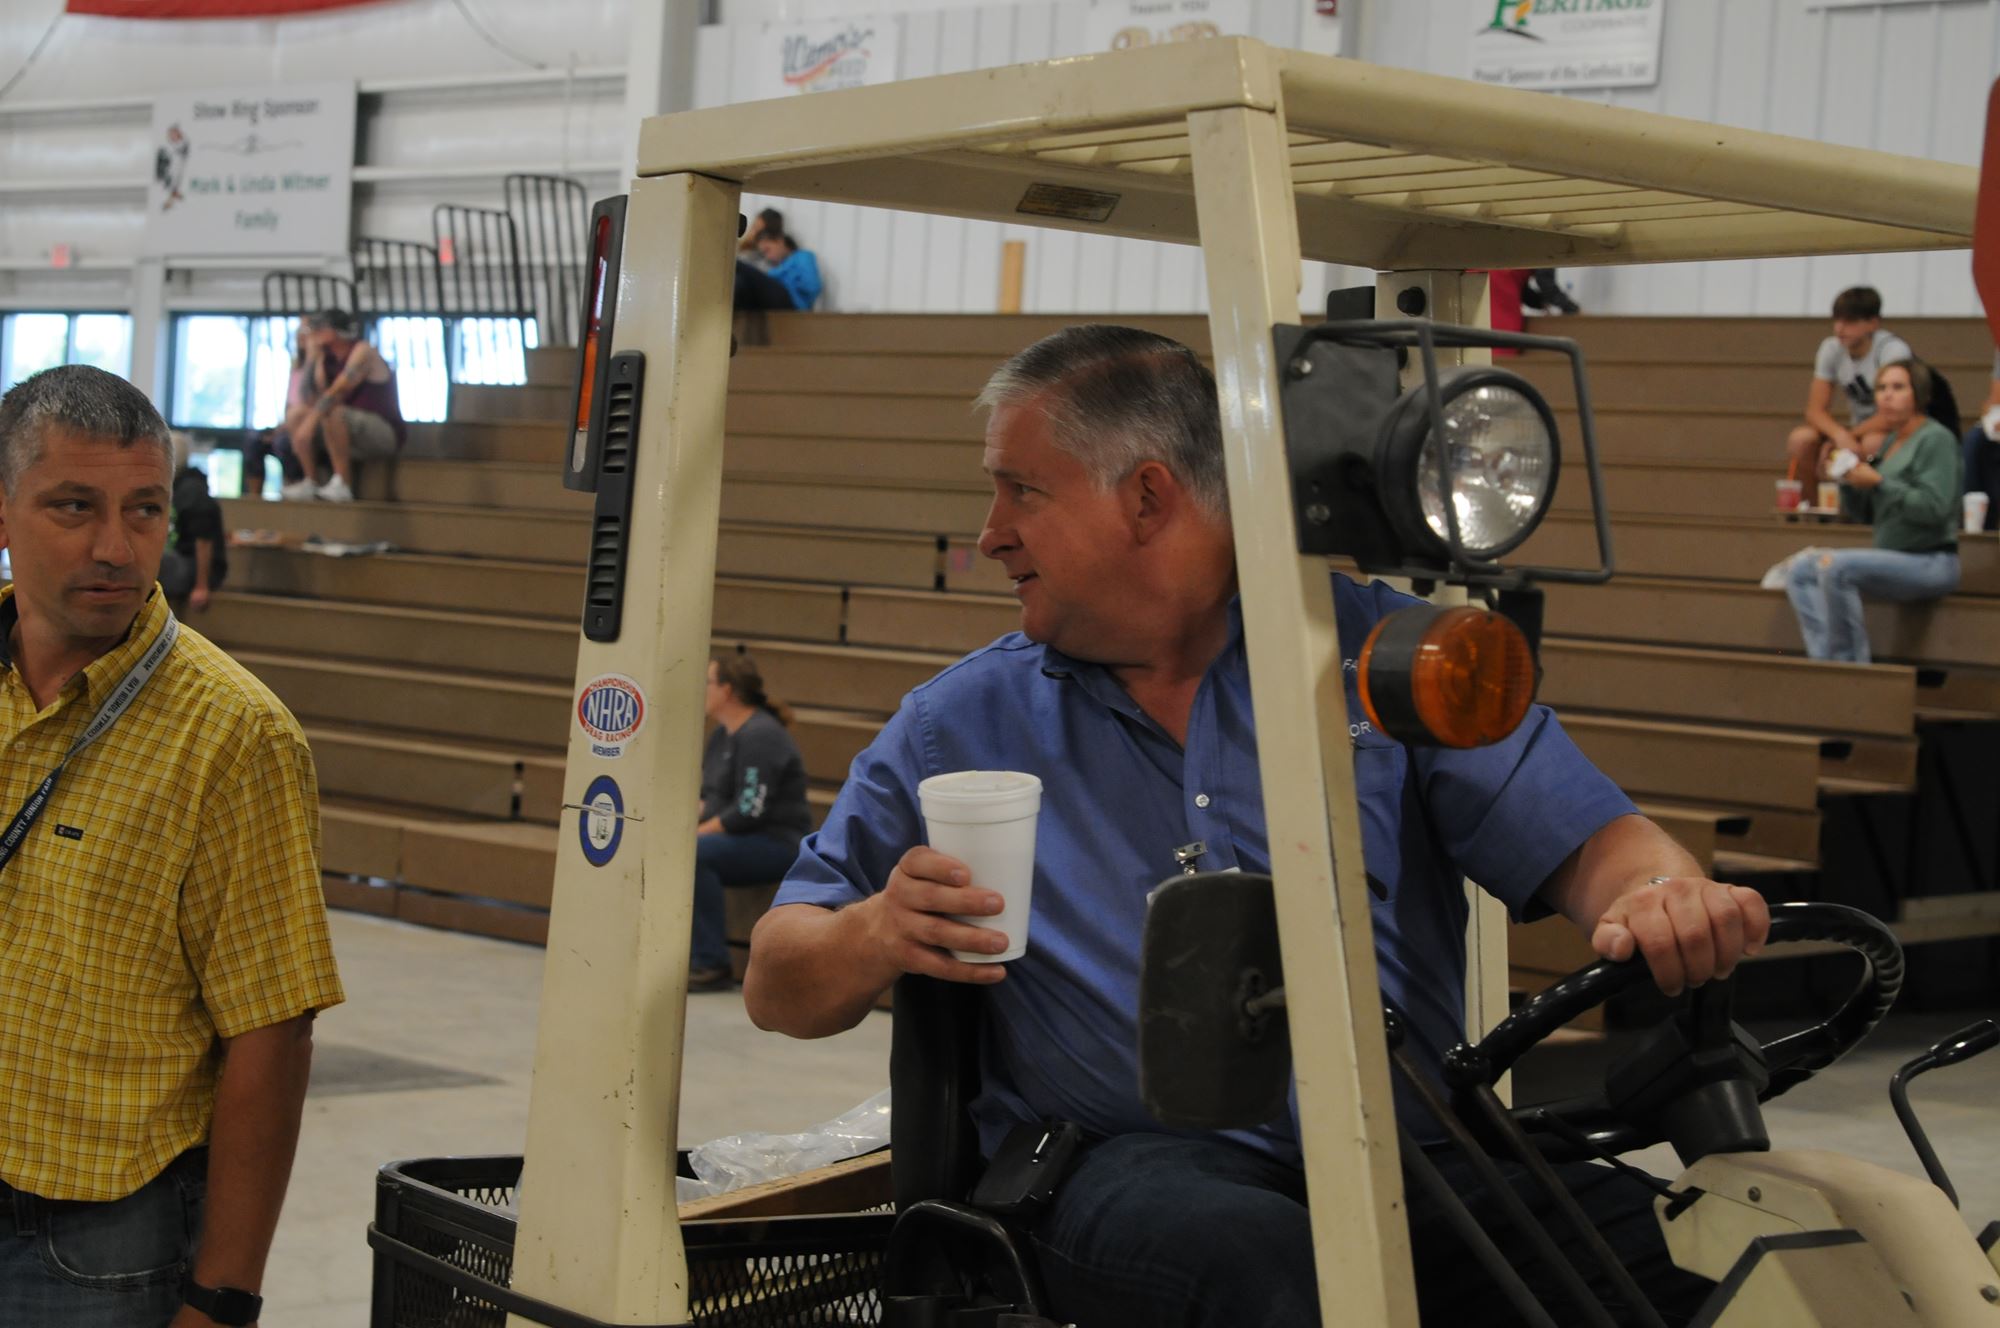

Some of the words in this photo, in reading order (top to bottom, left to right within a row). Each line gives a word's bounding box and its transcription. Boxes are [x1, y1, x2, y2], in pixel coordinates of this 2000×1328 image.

[193, 101, 226, 119] Show
[231, 98, 259, 123] Ring
[263, 97, 320, 118] Sponsor
[190, 176, 220, 193] Mark
[233, 209, 280, 232] Family
[587, 689, 634, 731] NHRA
[1349, 721, 1372, 737] OR
[4, 818, 27, 847] COUNTY
[24, 795, 45, 820] JUNIOR
